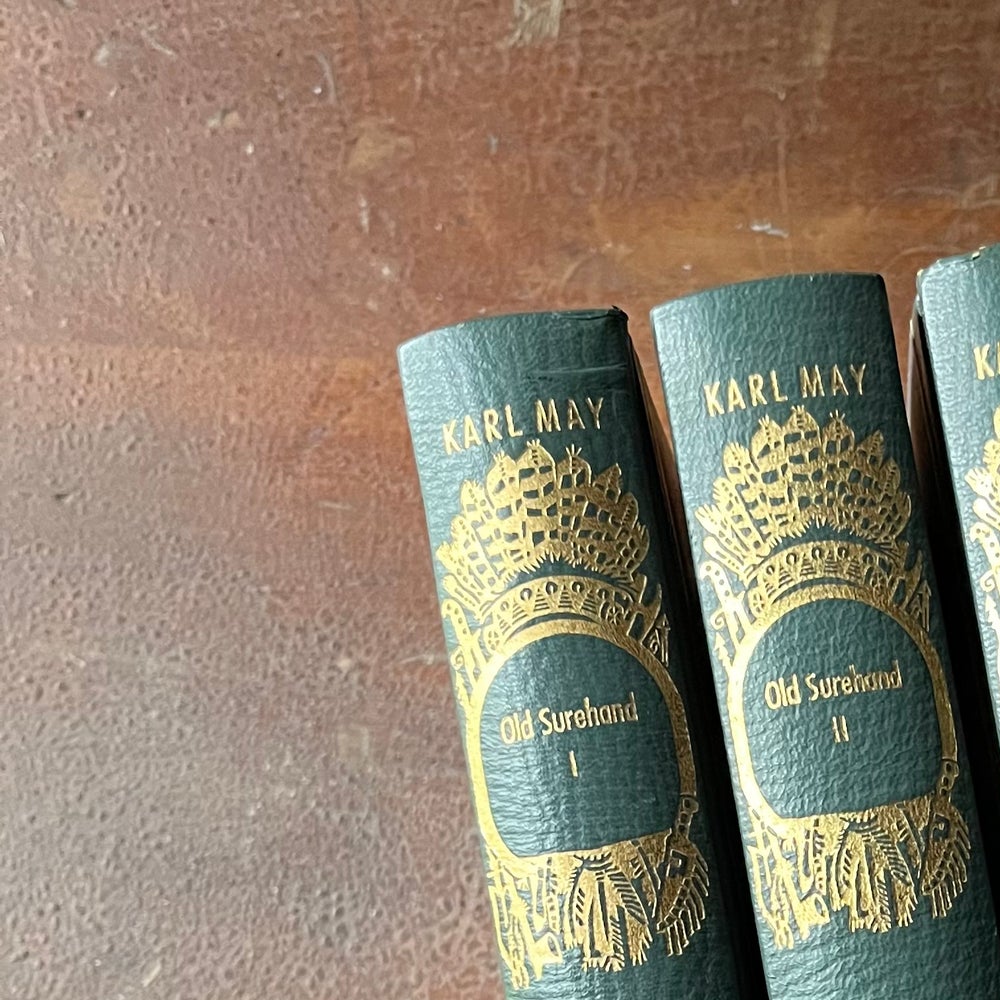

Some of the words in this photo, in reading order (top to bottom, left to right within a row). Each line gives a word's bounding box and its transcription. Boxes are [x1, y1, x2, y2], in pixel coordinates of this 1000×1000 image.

[704, 370, 788, 417] KARL
[800, 363, 867, 398] MAY
[442, 402, 522, 455] KARL
[535, 397, 604, 433] MAY
[764, 677, 802, 711] Old
[806, 660, 903, 702] Surehand
[500, 711, 534, 745] Old
[541, 692, 638, 737] Surehand
[832, 715, 850, 743] II
[569, 751, 578, 778] I
